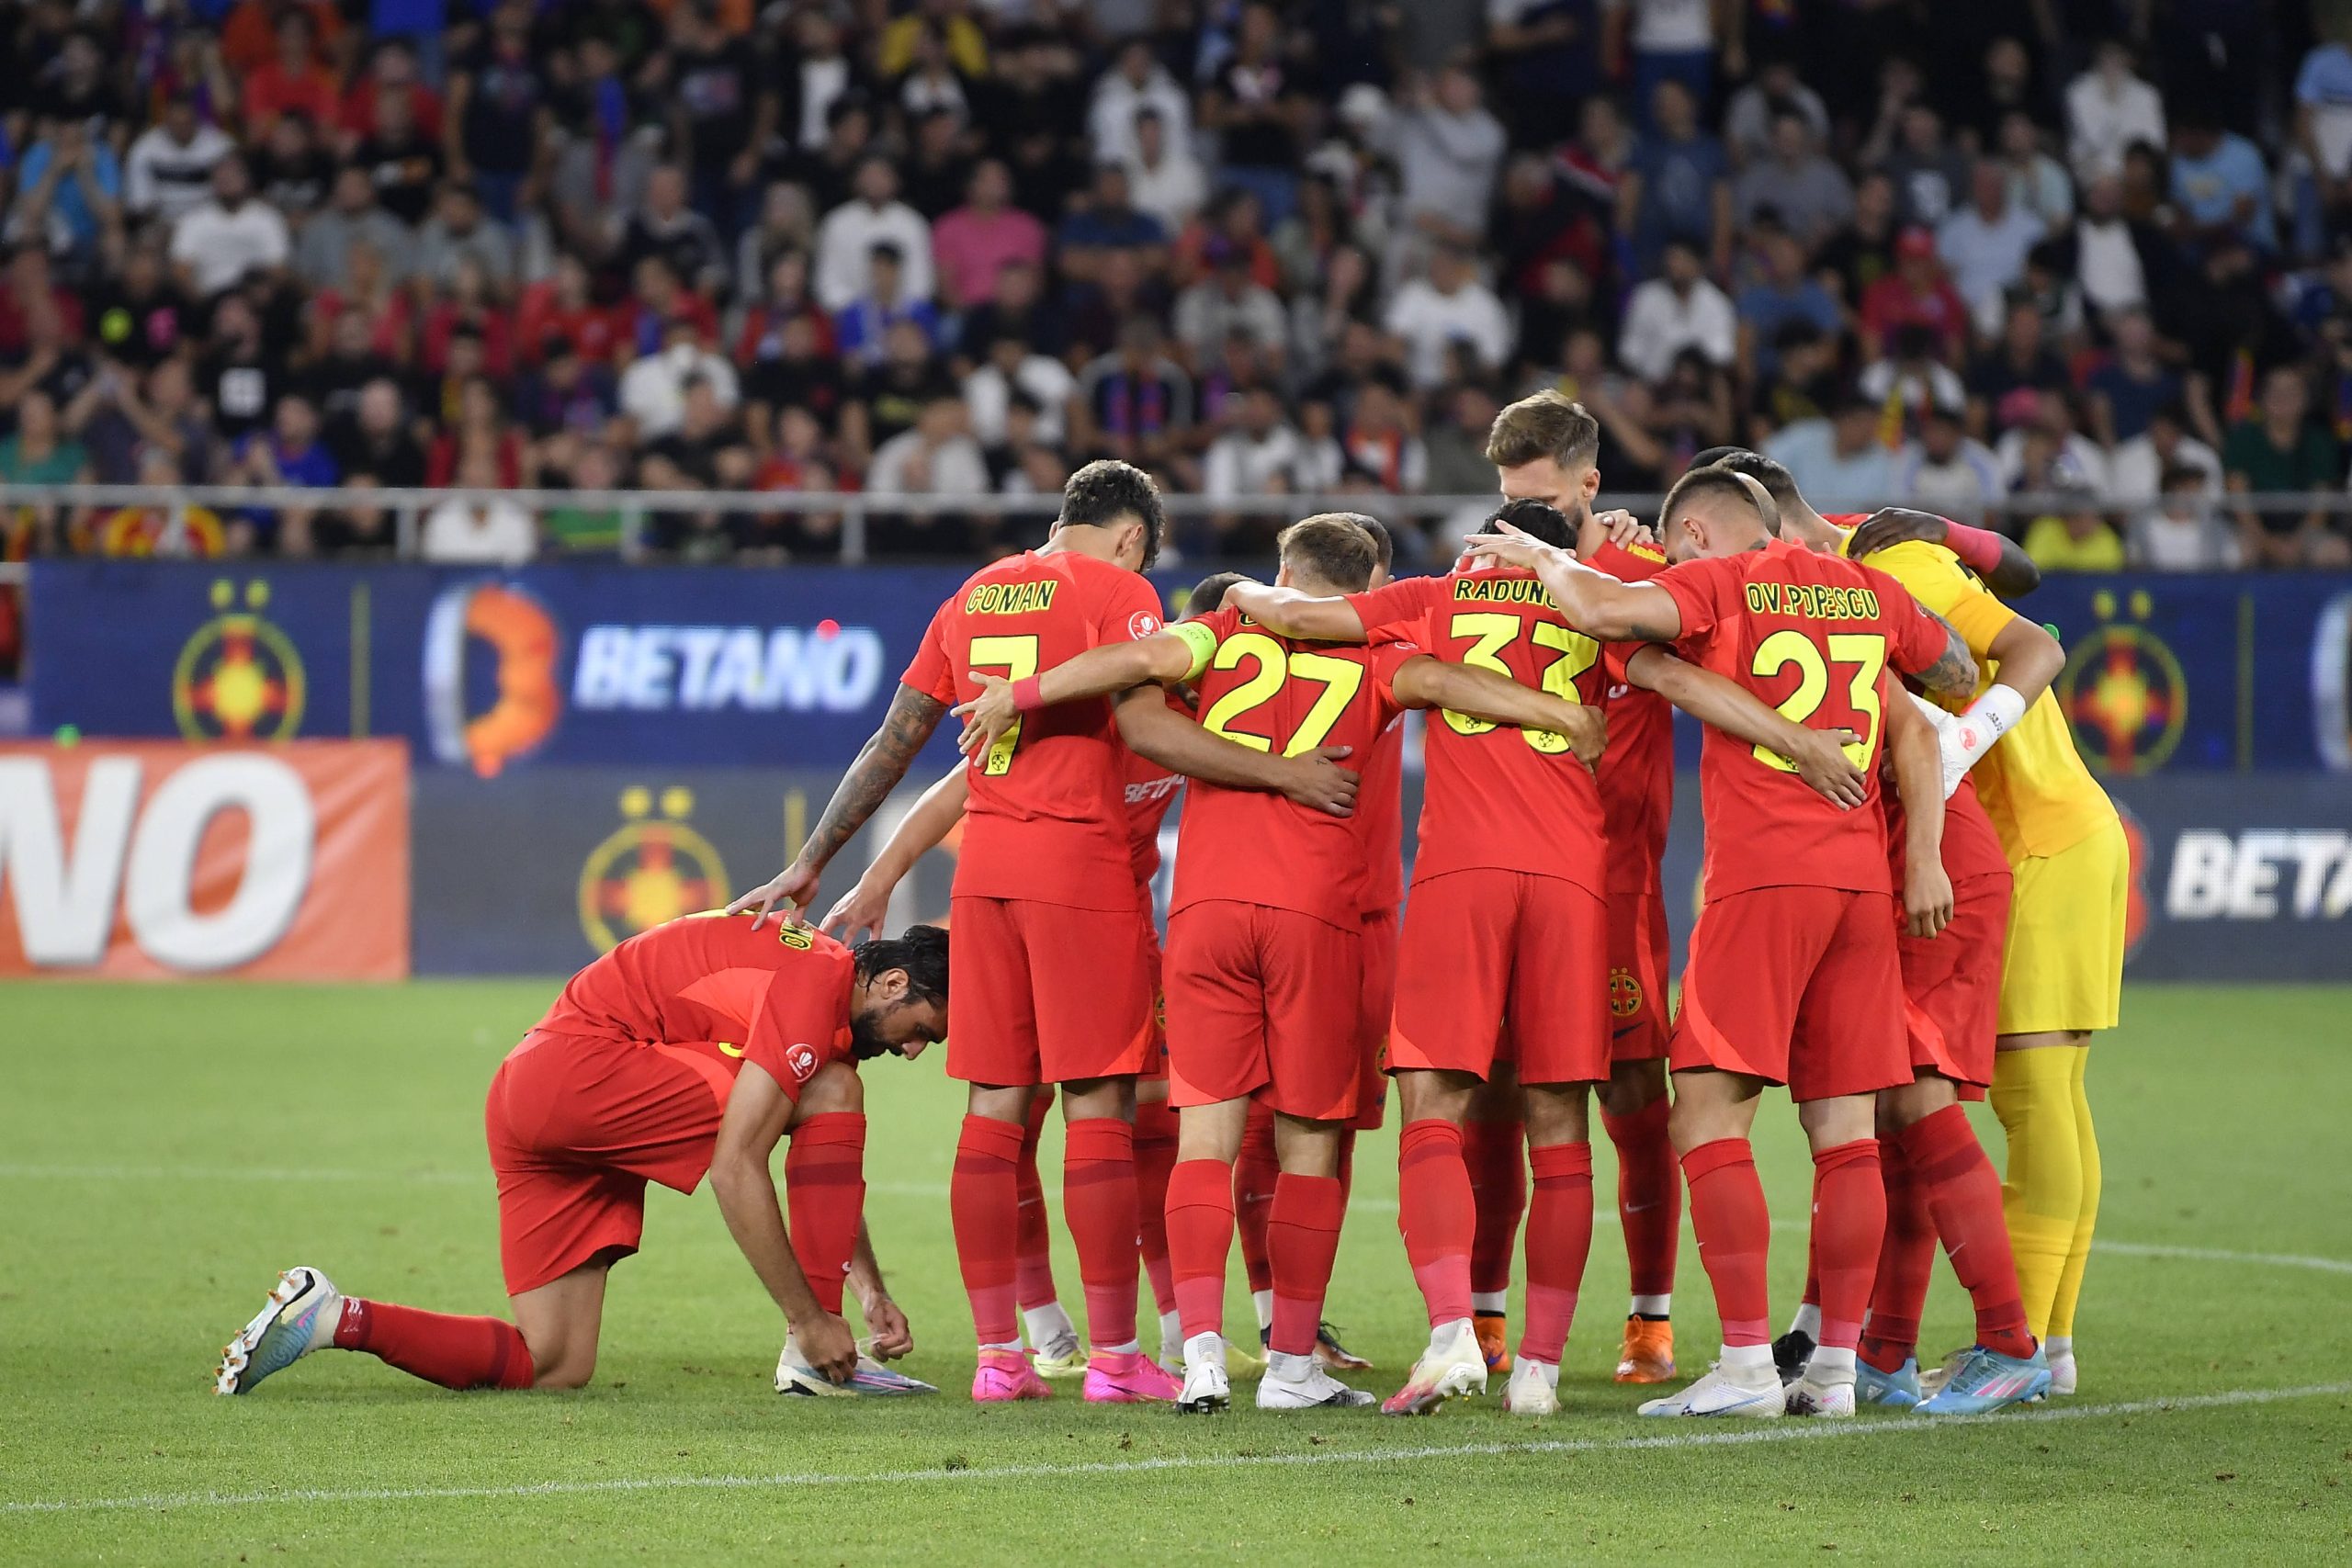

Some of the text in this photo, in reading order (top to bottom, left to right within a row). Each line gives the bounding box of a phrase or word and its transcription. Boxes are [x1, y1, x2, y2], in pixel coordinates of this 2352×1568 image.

[966, 581, 1057, 615] COMAN
[1453, 578, 1560, 611] RADUN
[574, 625, 885, 712] BETANO
[969, 634, 1038, 776] 7
[1202, 632, 1364, 758] 27
[1442, 612, 1600, 755] 33
[1751, 629, 1885, 774] 23
